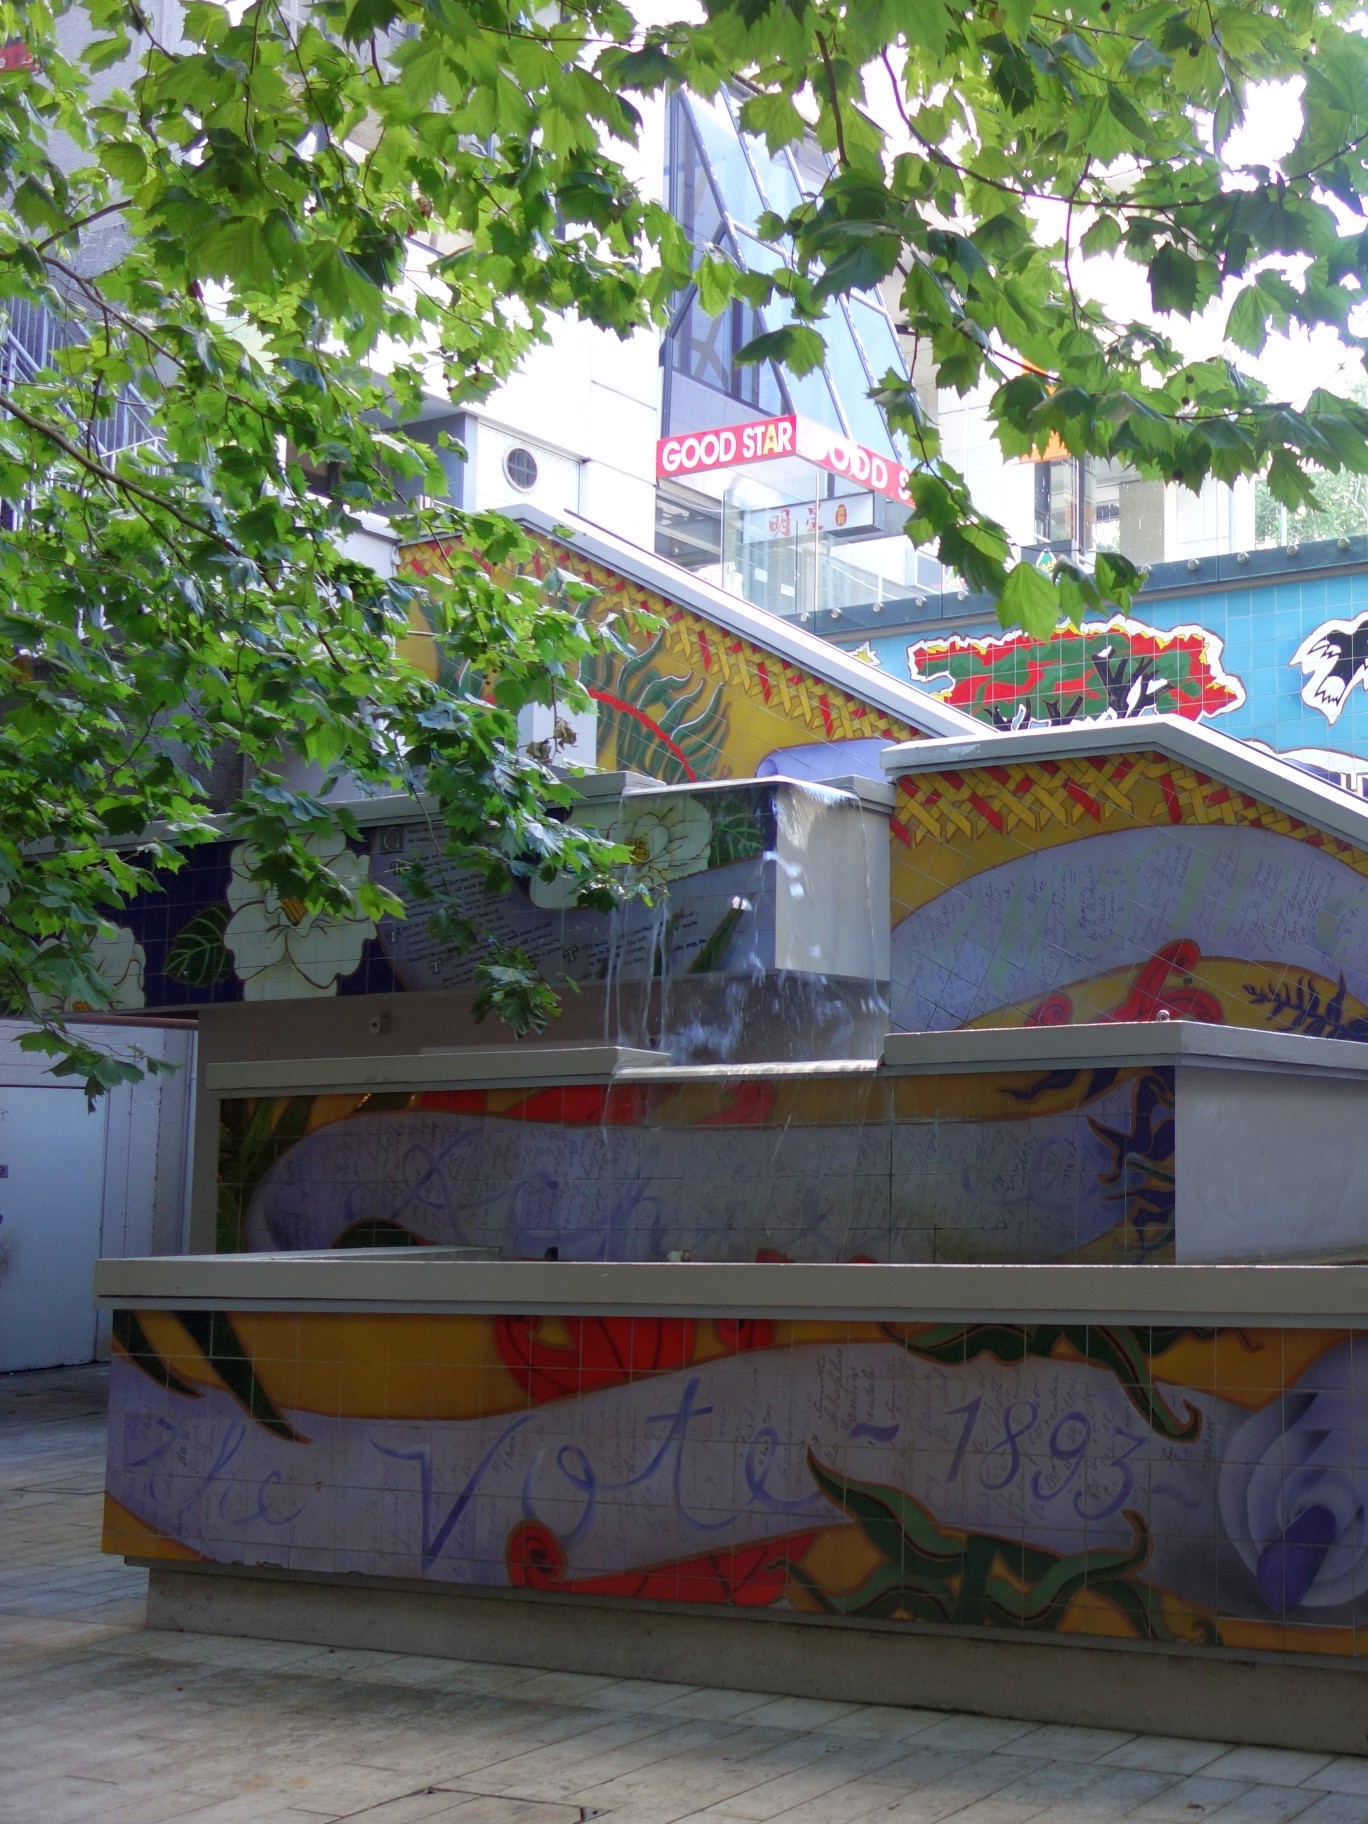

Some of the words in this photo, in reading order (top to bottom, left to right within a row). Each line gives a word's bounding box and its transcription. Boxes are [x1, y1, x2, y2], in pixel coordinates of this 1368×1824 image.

[662, 431, 737, 471] GOOD
[743, 422, 792, 459] STAR
[370, 1375, 824, 1571] Vote
[944, 1394, 1148, 1521] 1893
